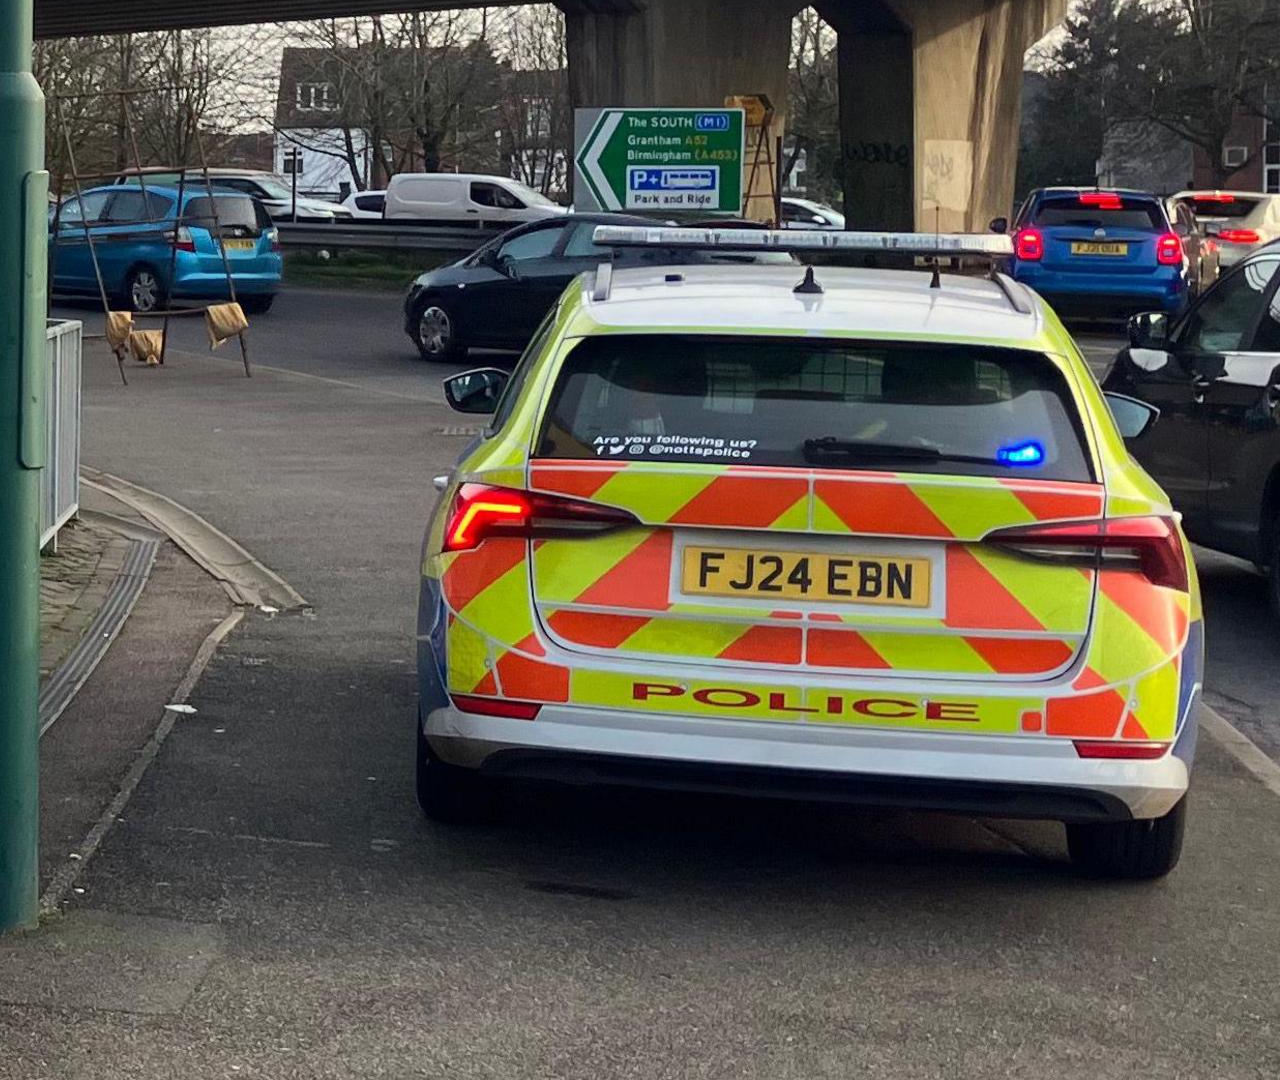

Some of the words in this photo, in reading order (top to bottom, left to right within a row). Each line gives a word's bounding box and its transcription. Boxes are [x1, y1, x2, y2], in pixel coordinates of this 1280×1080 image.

[628, 117, 647, 127] The
[651, 117, 692, 127] SOUTH
[628, 135, 681, 146] Grantham
[686, 136, 708, 145] A52
[628, 150, 691, 162] Birmingham
[634, 194, 659, 204] Park
[664, 194, 682, 204] and
[687, 194, 711, 205] Ride
[593, 436, 619, 445] Are
[624, 436, 651, 446] you
[656, 435, 725, 448] following
[729, 439, 757, 449] us?
[649, 445, 751, 458] @nottspolice
[699, 552, 813, 594] FJ24
[827, 558, 914, 600] EBN
[632, 682, 981, 723] POLICE
